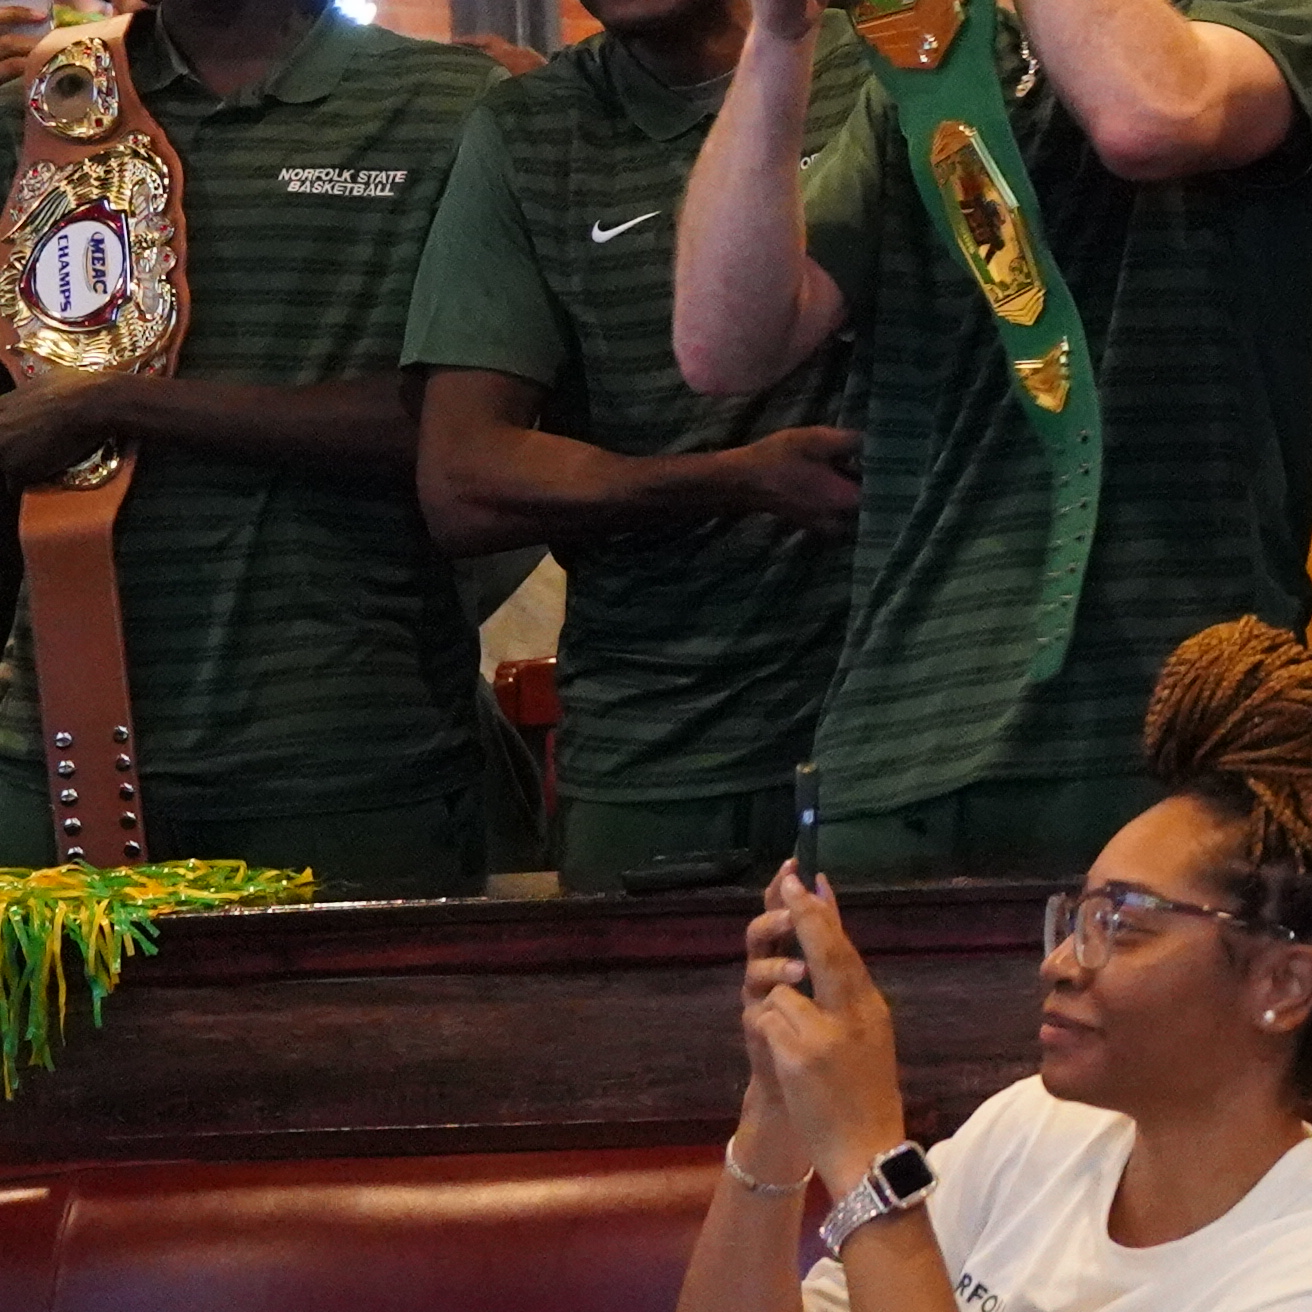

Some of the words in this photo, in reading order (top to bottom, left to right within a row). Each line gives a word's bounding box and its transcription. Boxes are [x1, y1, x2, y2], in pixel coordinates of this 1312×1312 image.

[278, 168, 354, 182] NORFOLK
[357, 170, 408, 184] STATE
[287, 181, 394, 196] BASKETBALL
[57, 234, 72, 313] CHAMPS
[89, 236, 108, 295] MEAC
